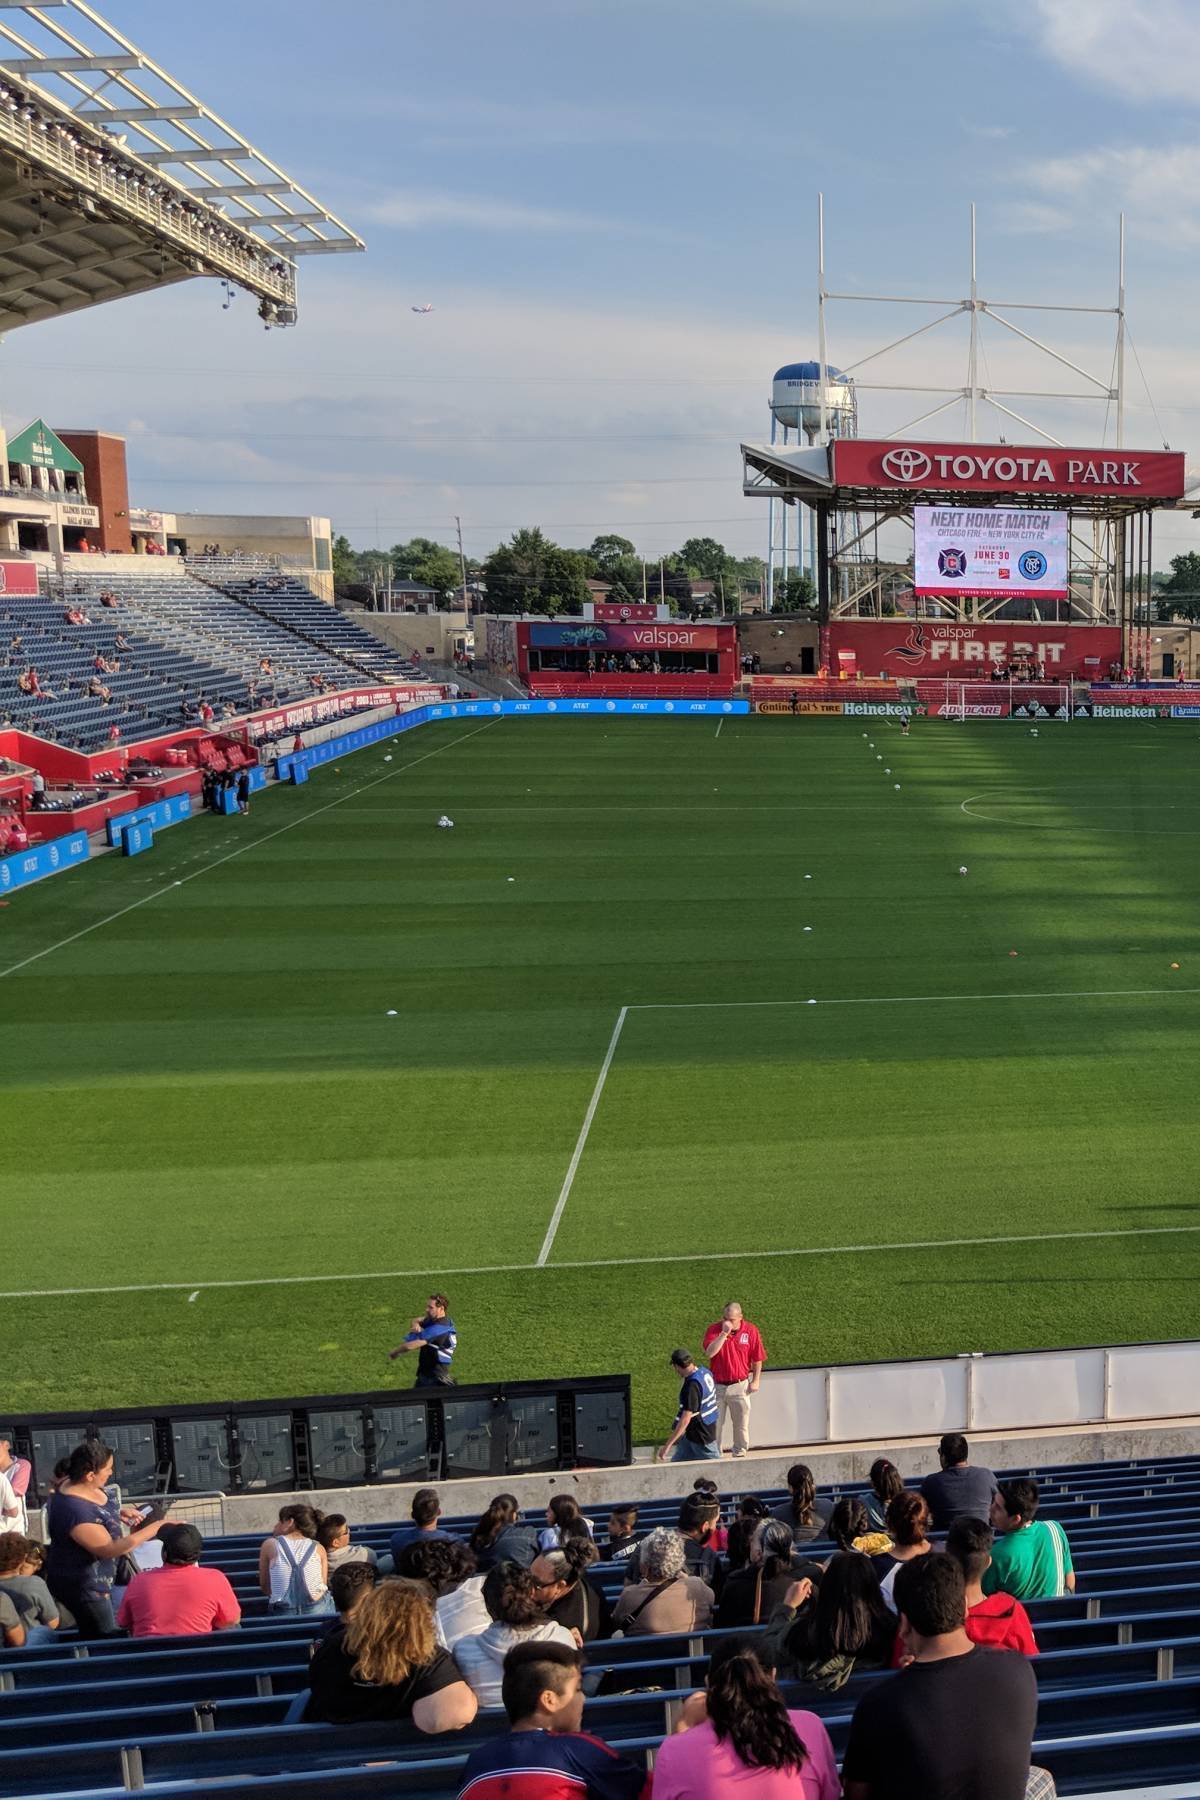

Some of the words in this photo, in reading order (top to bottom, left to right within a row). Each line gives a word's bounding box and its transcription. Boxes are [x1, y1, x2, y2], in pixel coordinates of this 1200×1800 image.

[934, 454, 1055, 483] TOYOTA
[1067, 460, 1142, 485] PARK
[930, 511, 964, 527] NEXT
[965, 512, 1004, 529] HOME
[1005, 514, 1050, 530] MATCH
[937, 528, 966, 537] CHICAGO
[967, 529, 981, 538] FIRE
[988, 530, 1002, 538] NEW
[1003, 530, 1020, 539] YORK
[1020, 531, 1036, 540] CITY
[1036, 531, 1045, 540] FC
[974, 550, 996, 560] JUNE
[998, 551, 1010, 560] 30
[632, 626, 698, 648] valspar
[931, 624, 977, 640] valspar
[930, 639, 1007, 661] FIRE
[514, 703, 532, 711] AT&T
[572, 702, 589, 710] AT&T
[689, 703, 706, 711] AT&T
[758, 702, 811, 713] Continetal
[844, 702, 912, 716] Heineken
[937, 704, 1001, 716] ADVOCARE
[1092, 705, 1156, 718] Heineken
[70, 839, 83, 854] AT&T
[23, 856, 38, 874] AT&T
